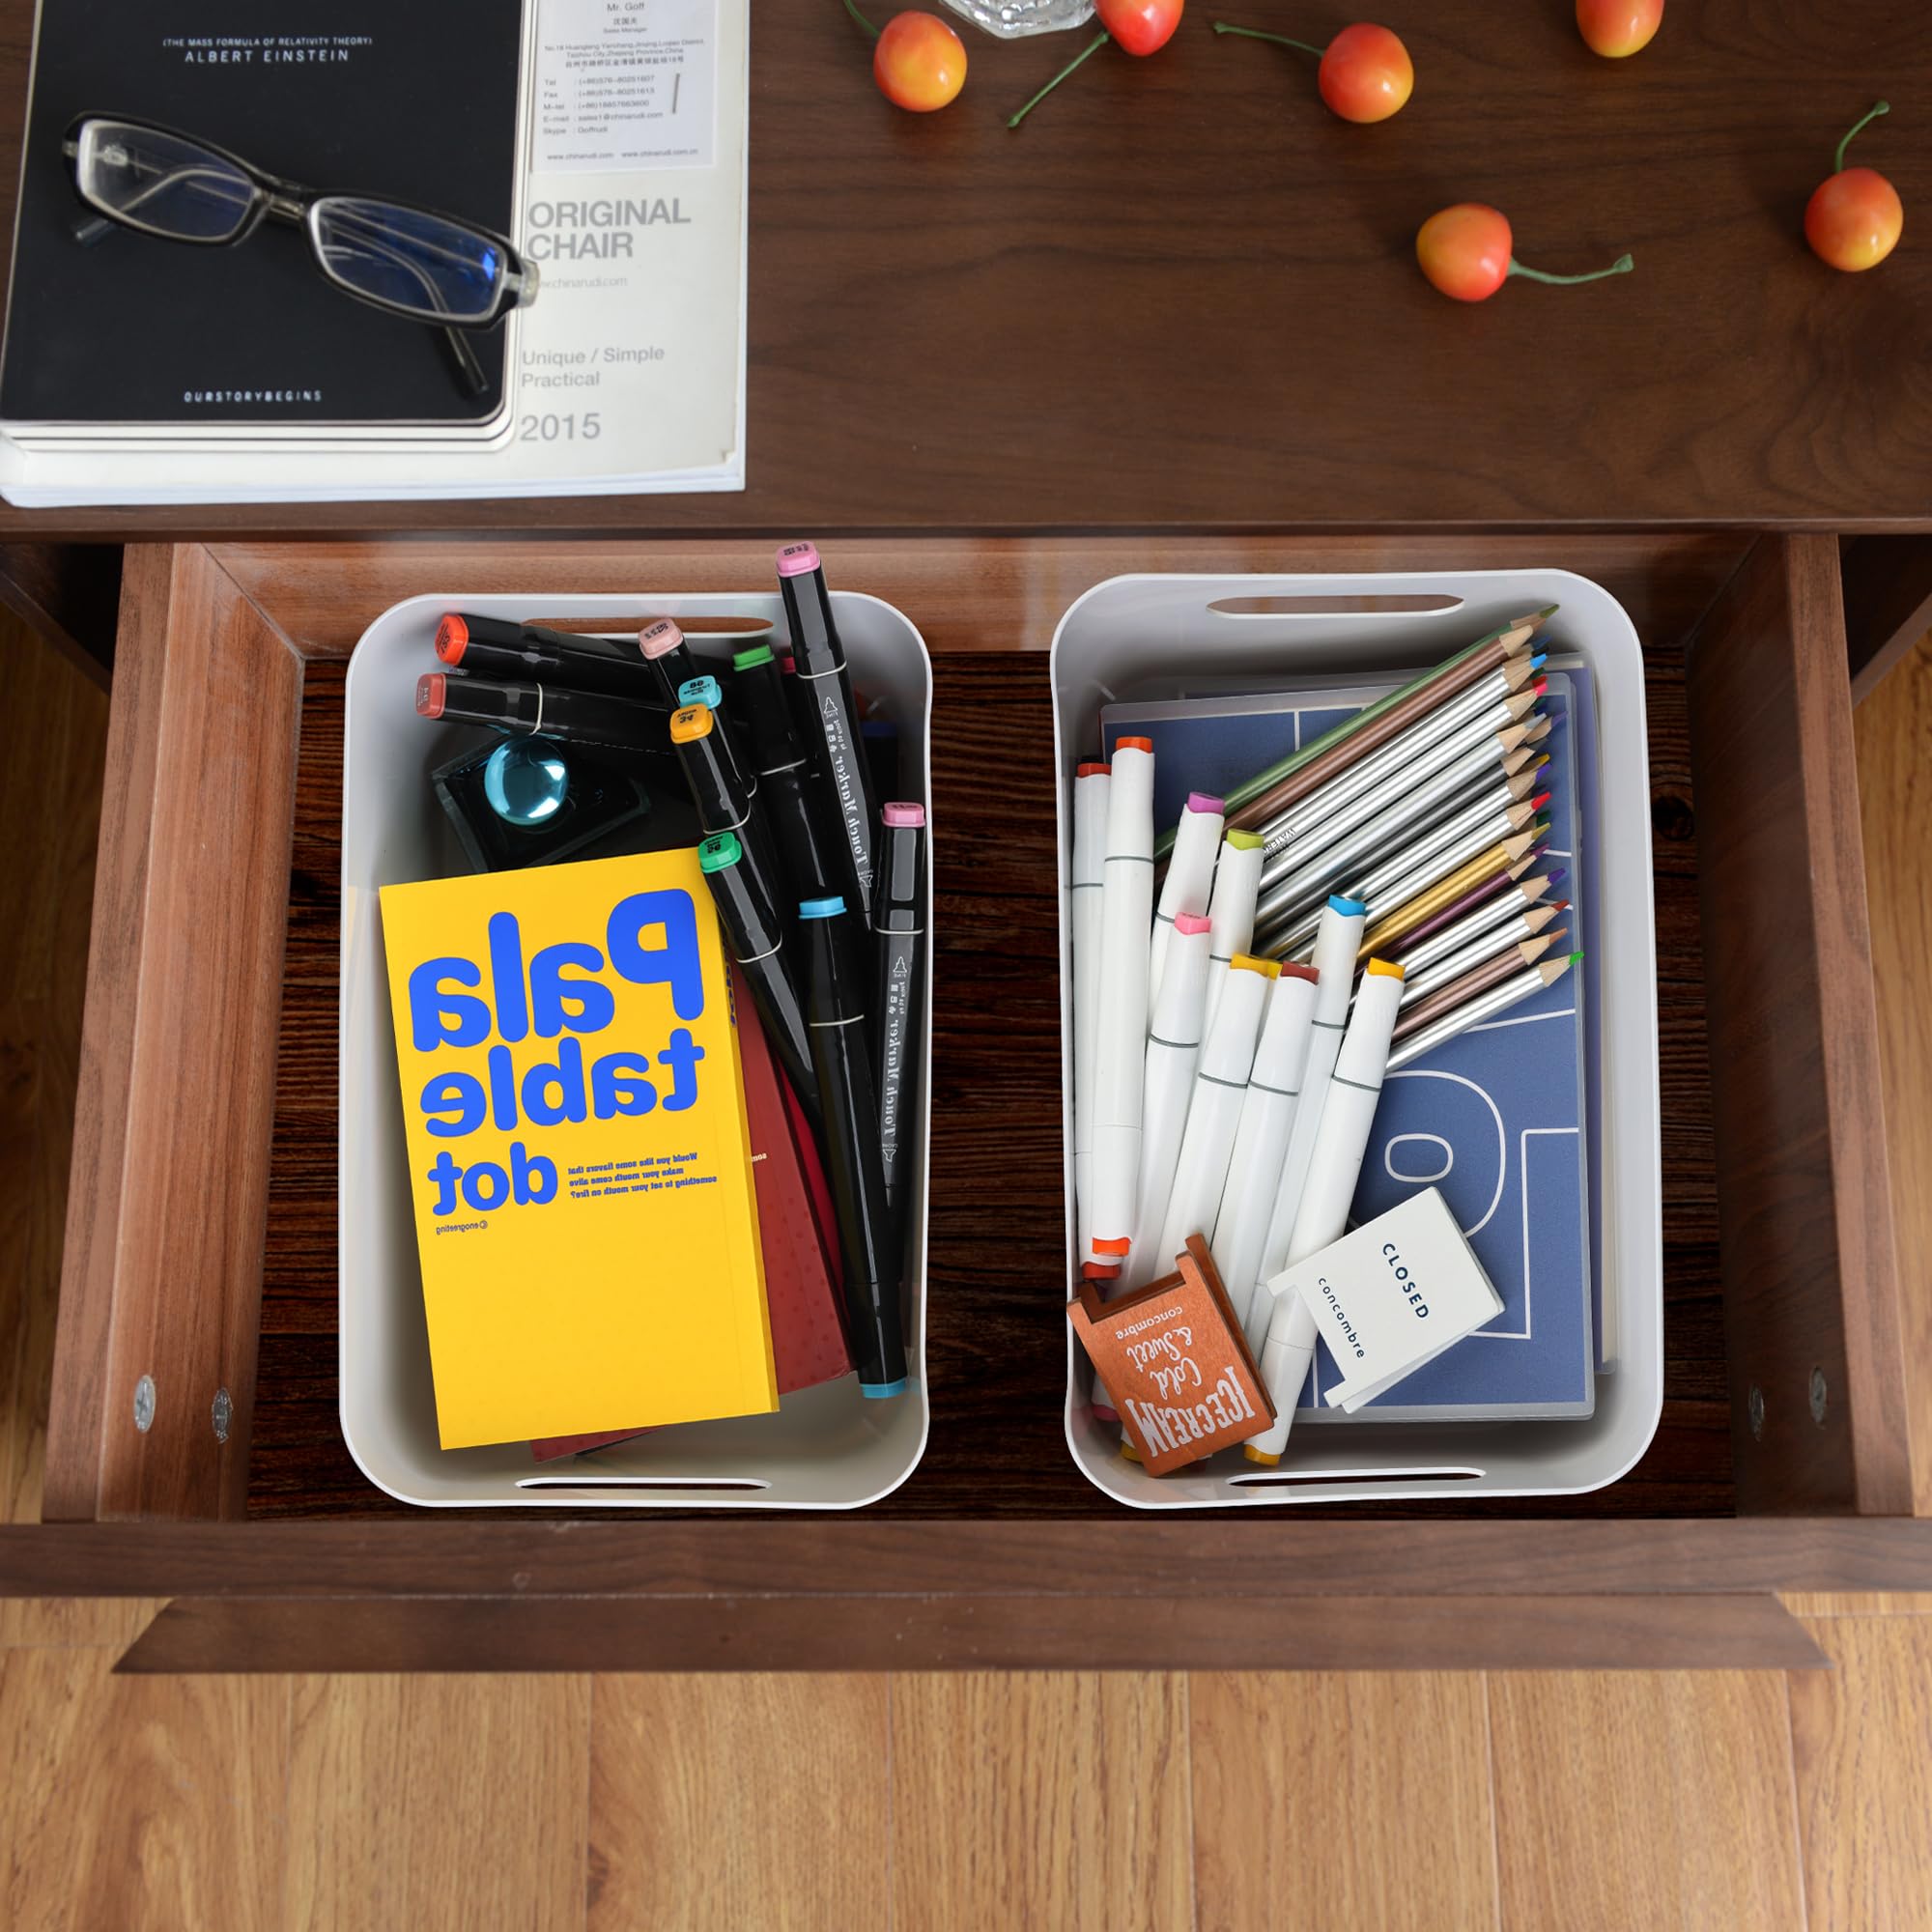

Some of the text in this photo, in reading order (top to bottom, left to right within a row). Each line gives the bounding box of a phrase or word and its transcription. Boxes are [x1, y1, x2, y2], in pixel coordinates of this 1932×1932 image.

[185, 49, 349, 63] ALBERT EINSTEIN
[188, 38, 213, 46] MASS
[216, 38, 260, 46] FORMULA
[278, 37, 328, 45] RELATIVITY
[528, 197, 692, 229] ORIGINAL
[527, 232, 634, 261] CHAIR
[523, 350, 586, 367] Unique
[603, 346, 665, 364] Simple
[521, 371, 600, 388] Practical
[520, 412, 601, 441] 2015
[1382, 1243, 1429, 1319] CLOSED
[1116, 1306, 1183, 1341] concombre
[1319, 1277, 1365, 1358] concombre
[1150, 1357, 1203, 1400] Cold
